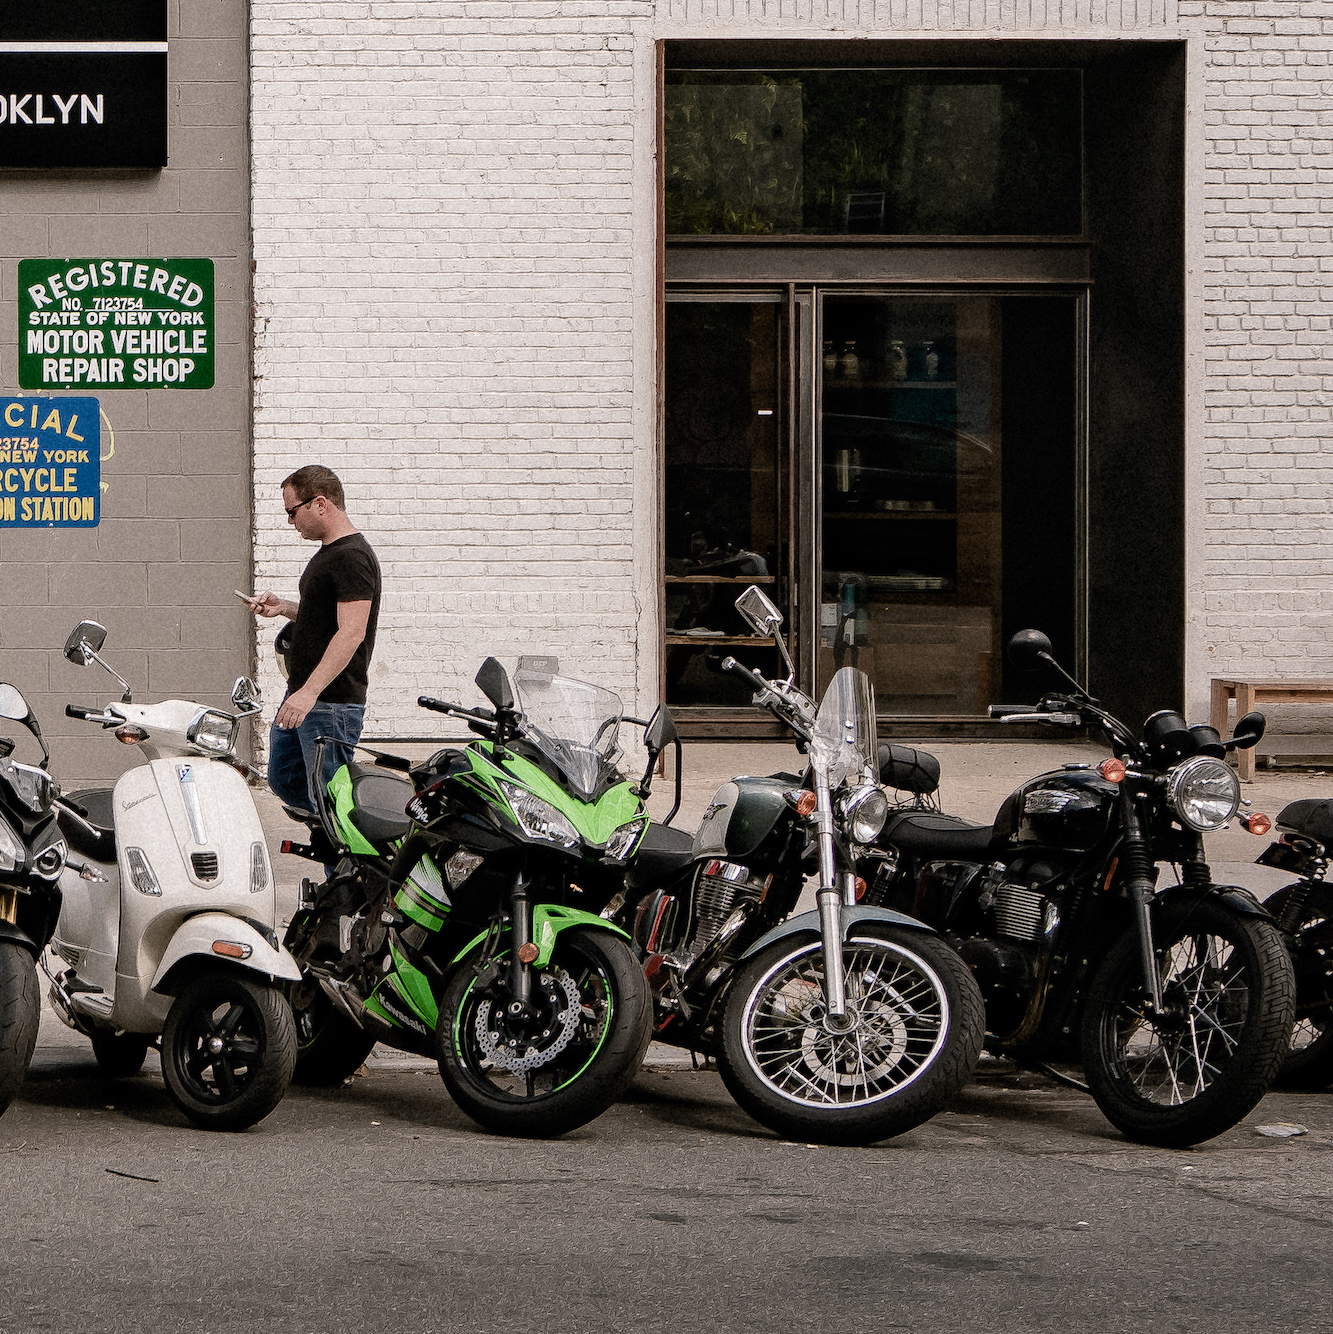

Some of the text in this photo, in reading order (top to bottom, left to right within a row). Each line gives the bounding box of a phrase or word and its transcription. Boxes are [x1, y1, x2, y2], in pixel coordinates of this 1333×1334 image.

[27, 261, 204, 310] REGISTERED
[62, 297, 144, 311] NO. 7123754
[29, 312, 205, 326] STATE OF NEW YORK
[27, 329, 208, 354] MOTOR VEHICLE
[42, 358, 195, 383] REPAIR SHOP
[0, 450, 38, 464] NEW
[43, 450, 90, 464] YORK
[21, 496, 94, 521] STATION
[410, 797, 429, 823] Ninja
[379, 992, 427, 1036] Kawasaki
